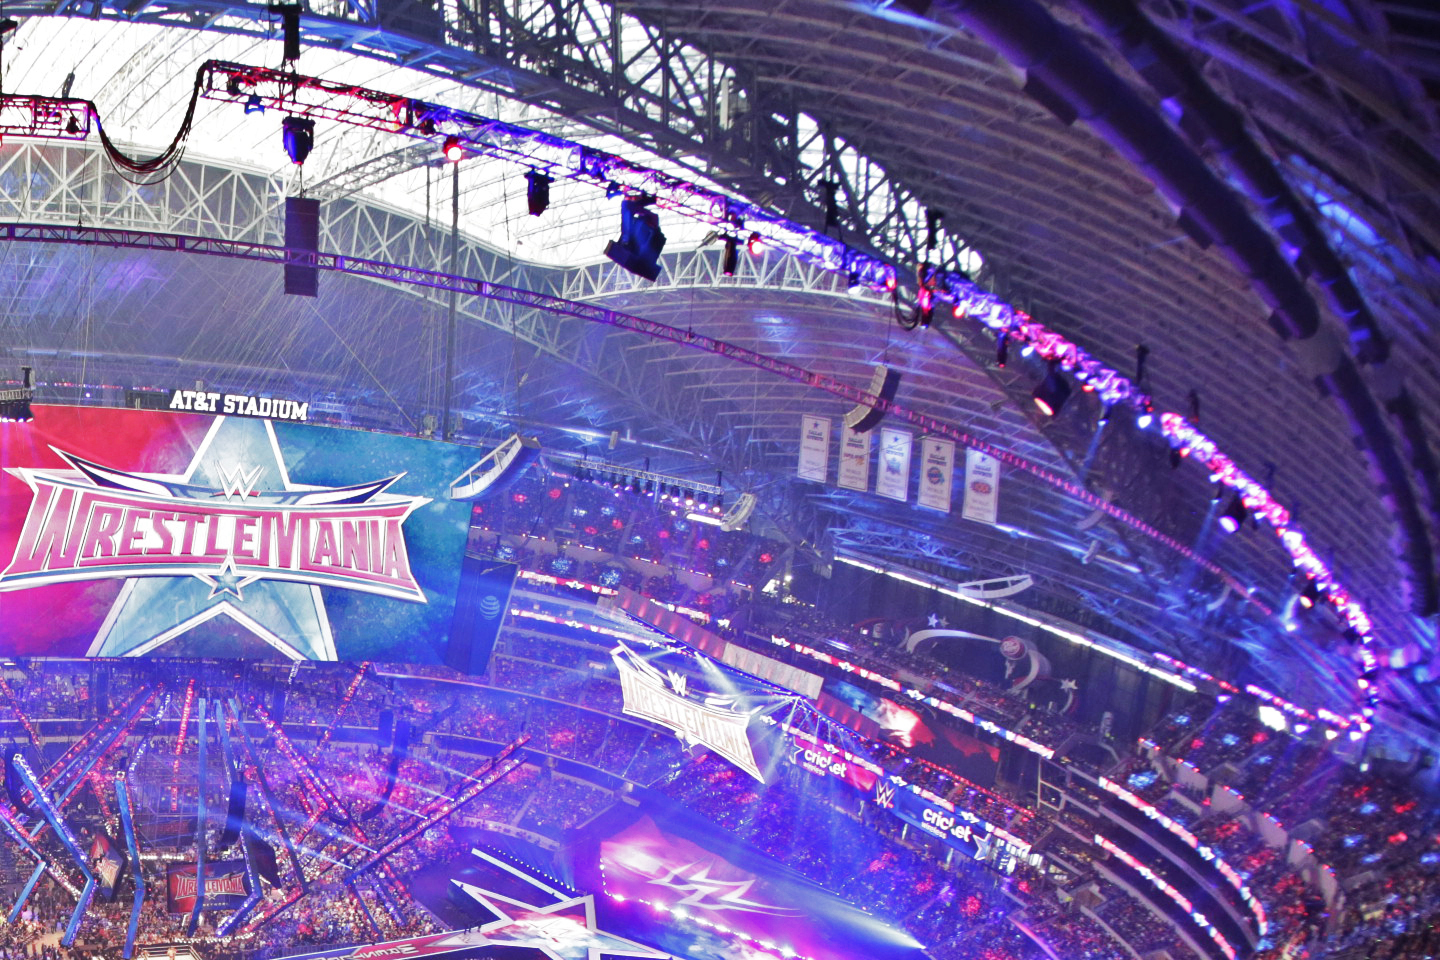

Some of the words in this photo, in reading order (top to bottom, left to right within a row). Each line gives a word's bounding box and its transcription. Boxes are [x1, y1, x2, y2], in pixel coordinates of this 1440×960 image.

[169, 389, 221, 412] AT&T
[223, 394, 309, 420] STADIUM
[14, 482, 412, 580] WRESTLEMANIA
[922, 808, 972, 843] cricket
[177, 875, 243, 897] WRELEMANIA
